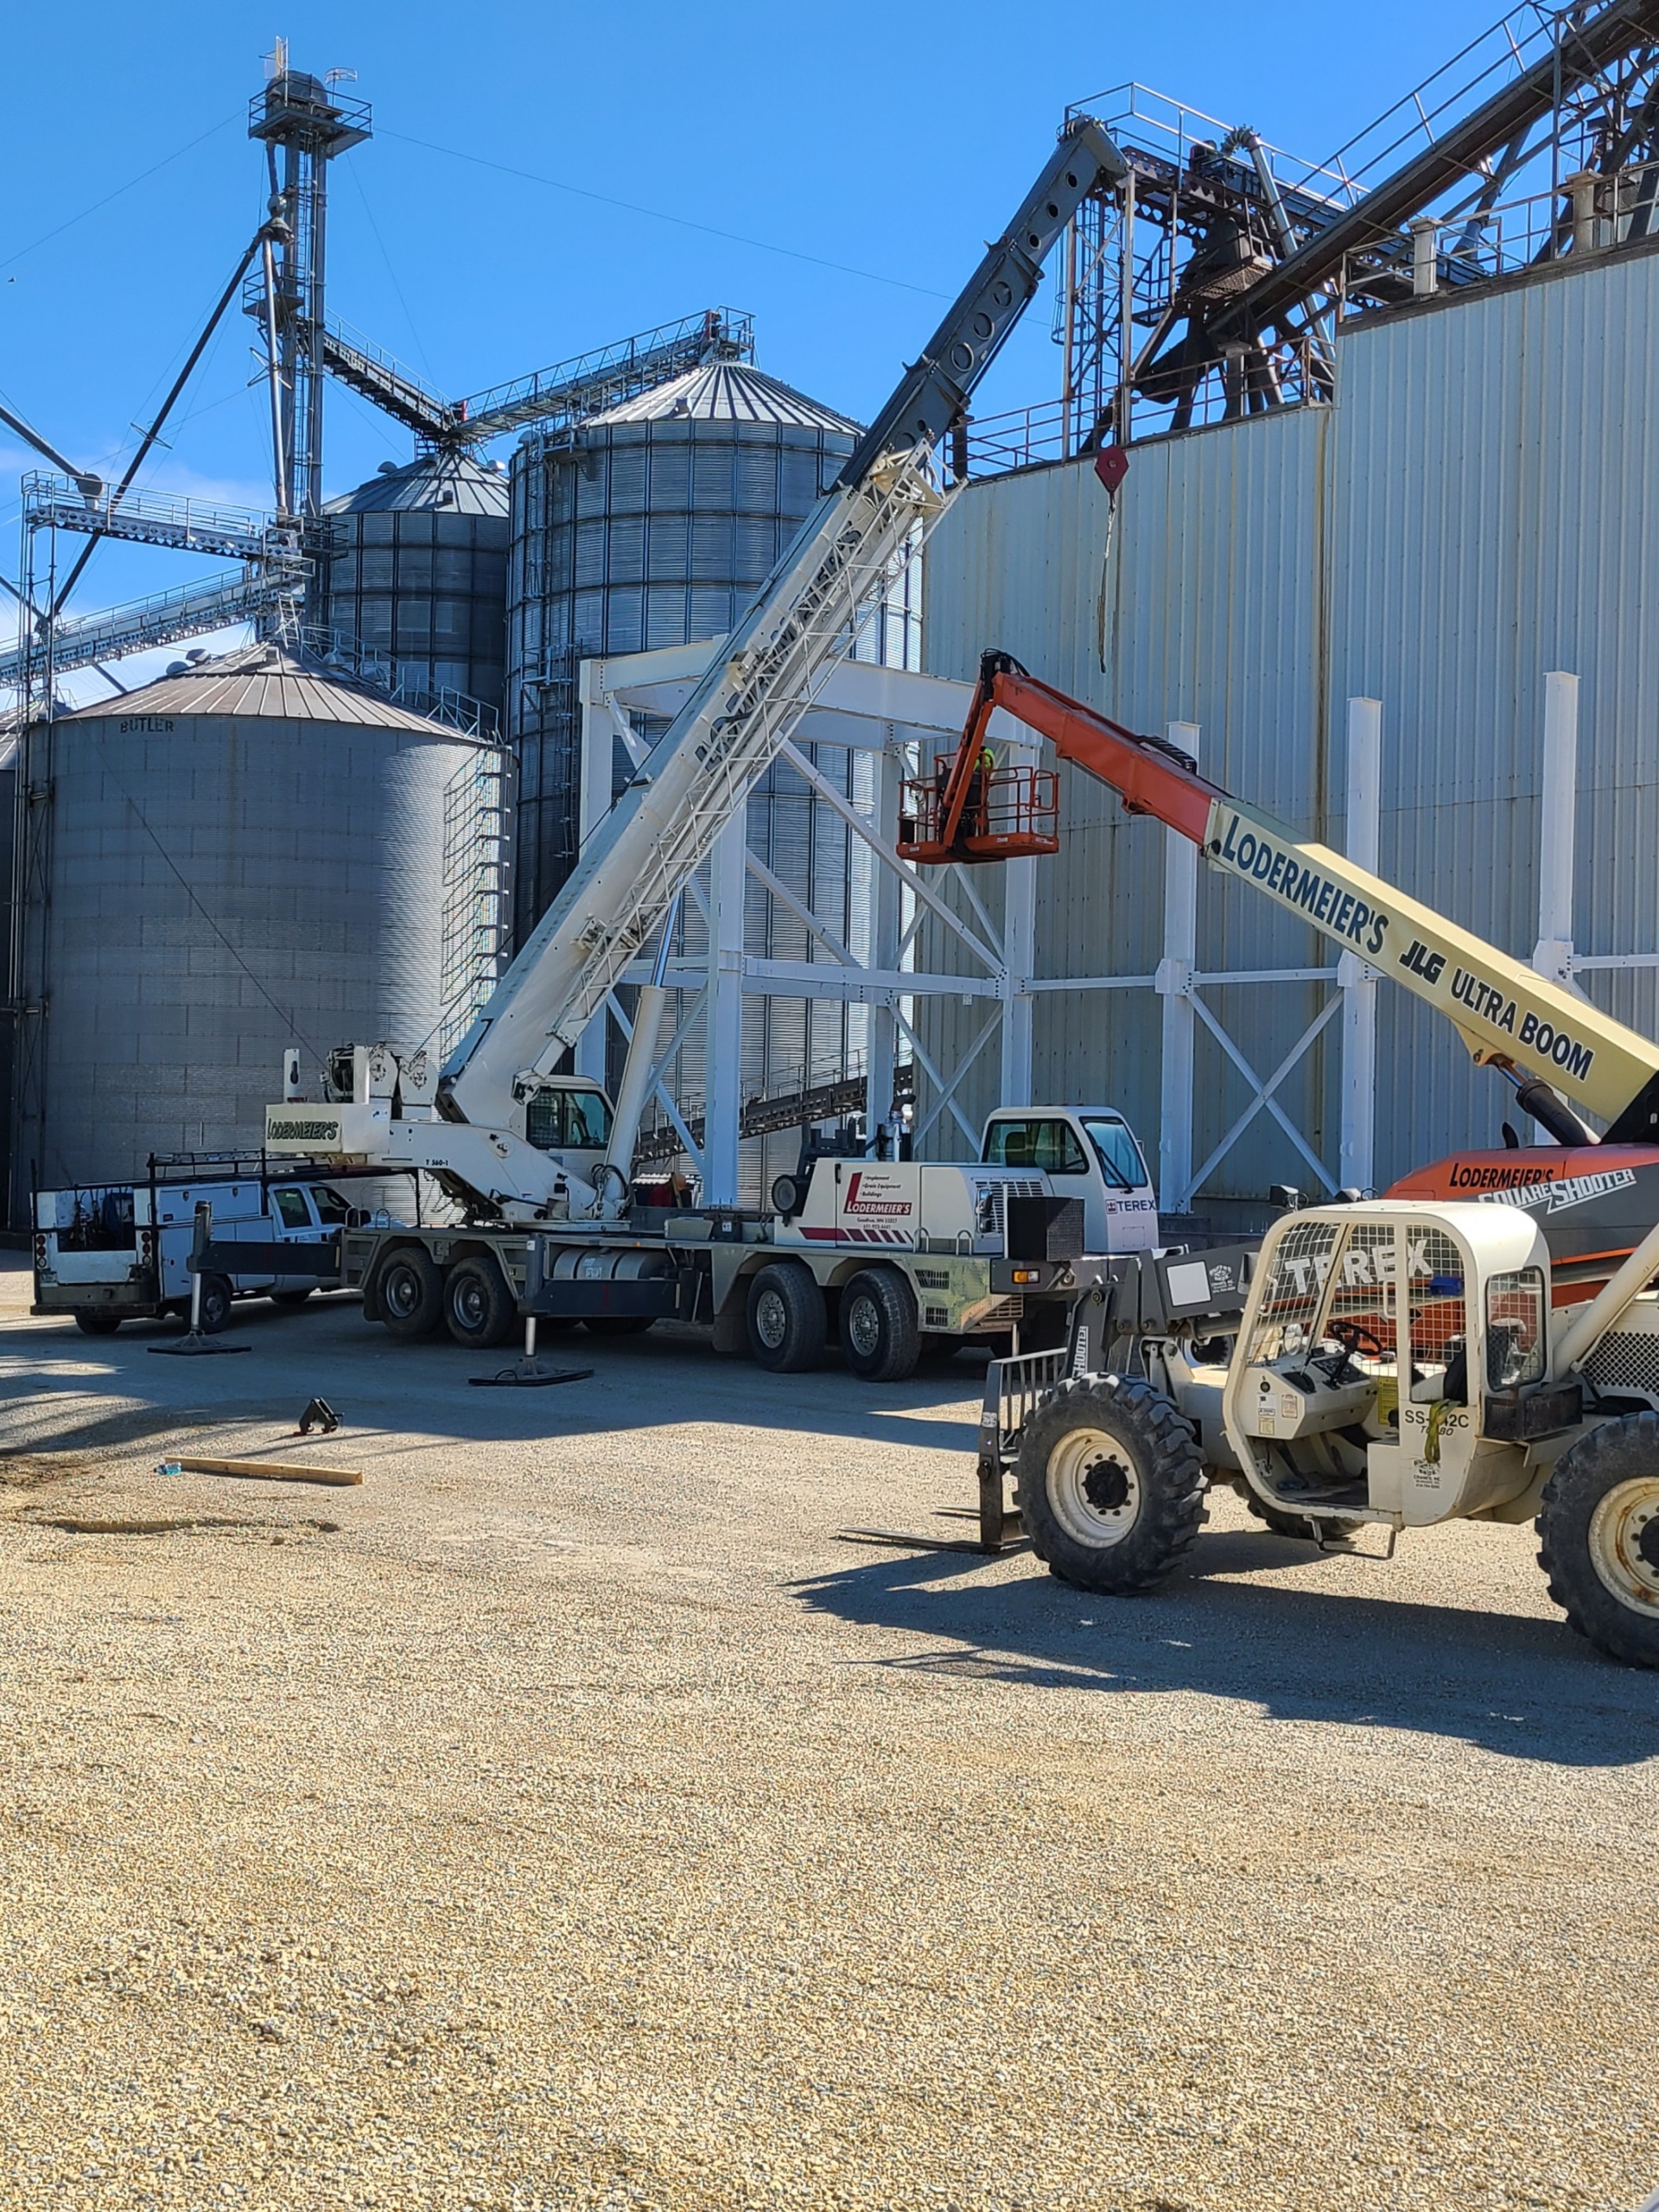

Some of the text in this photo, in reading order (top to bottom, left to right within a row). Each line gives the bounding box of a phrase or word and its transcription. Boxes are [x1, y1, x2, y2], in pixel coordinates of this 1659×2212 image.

[120, 717, 174, 733] BUTLER
[1222, 815, 1389, 954] LODERMEIER'S
[1399, 940, 1593, 1081] JLG ULTRA BOOM
[267, 1118, 339, 1141] LODERMEIER'S
[1549, 1168, 1636, 1206] SHOOTER
[847, 1201, 911, 1214] LODERMEIER'S
[1116, 1199, 1156, 1211] TEREX
[1285, 1239, 1433, 1295] TEREX
